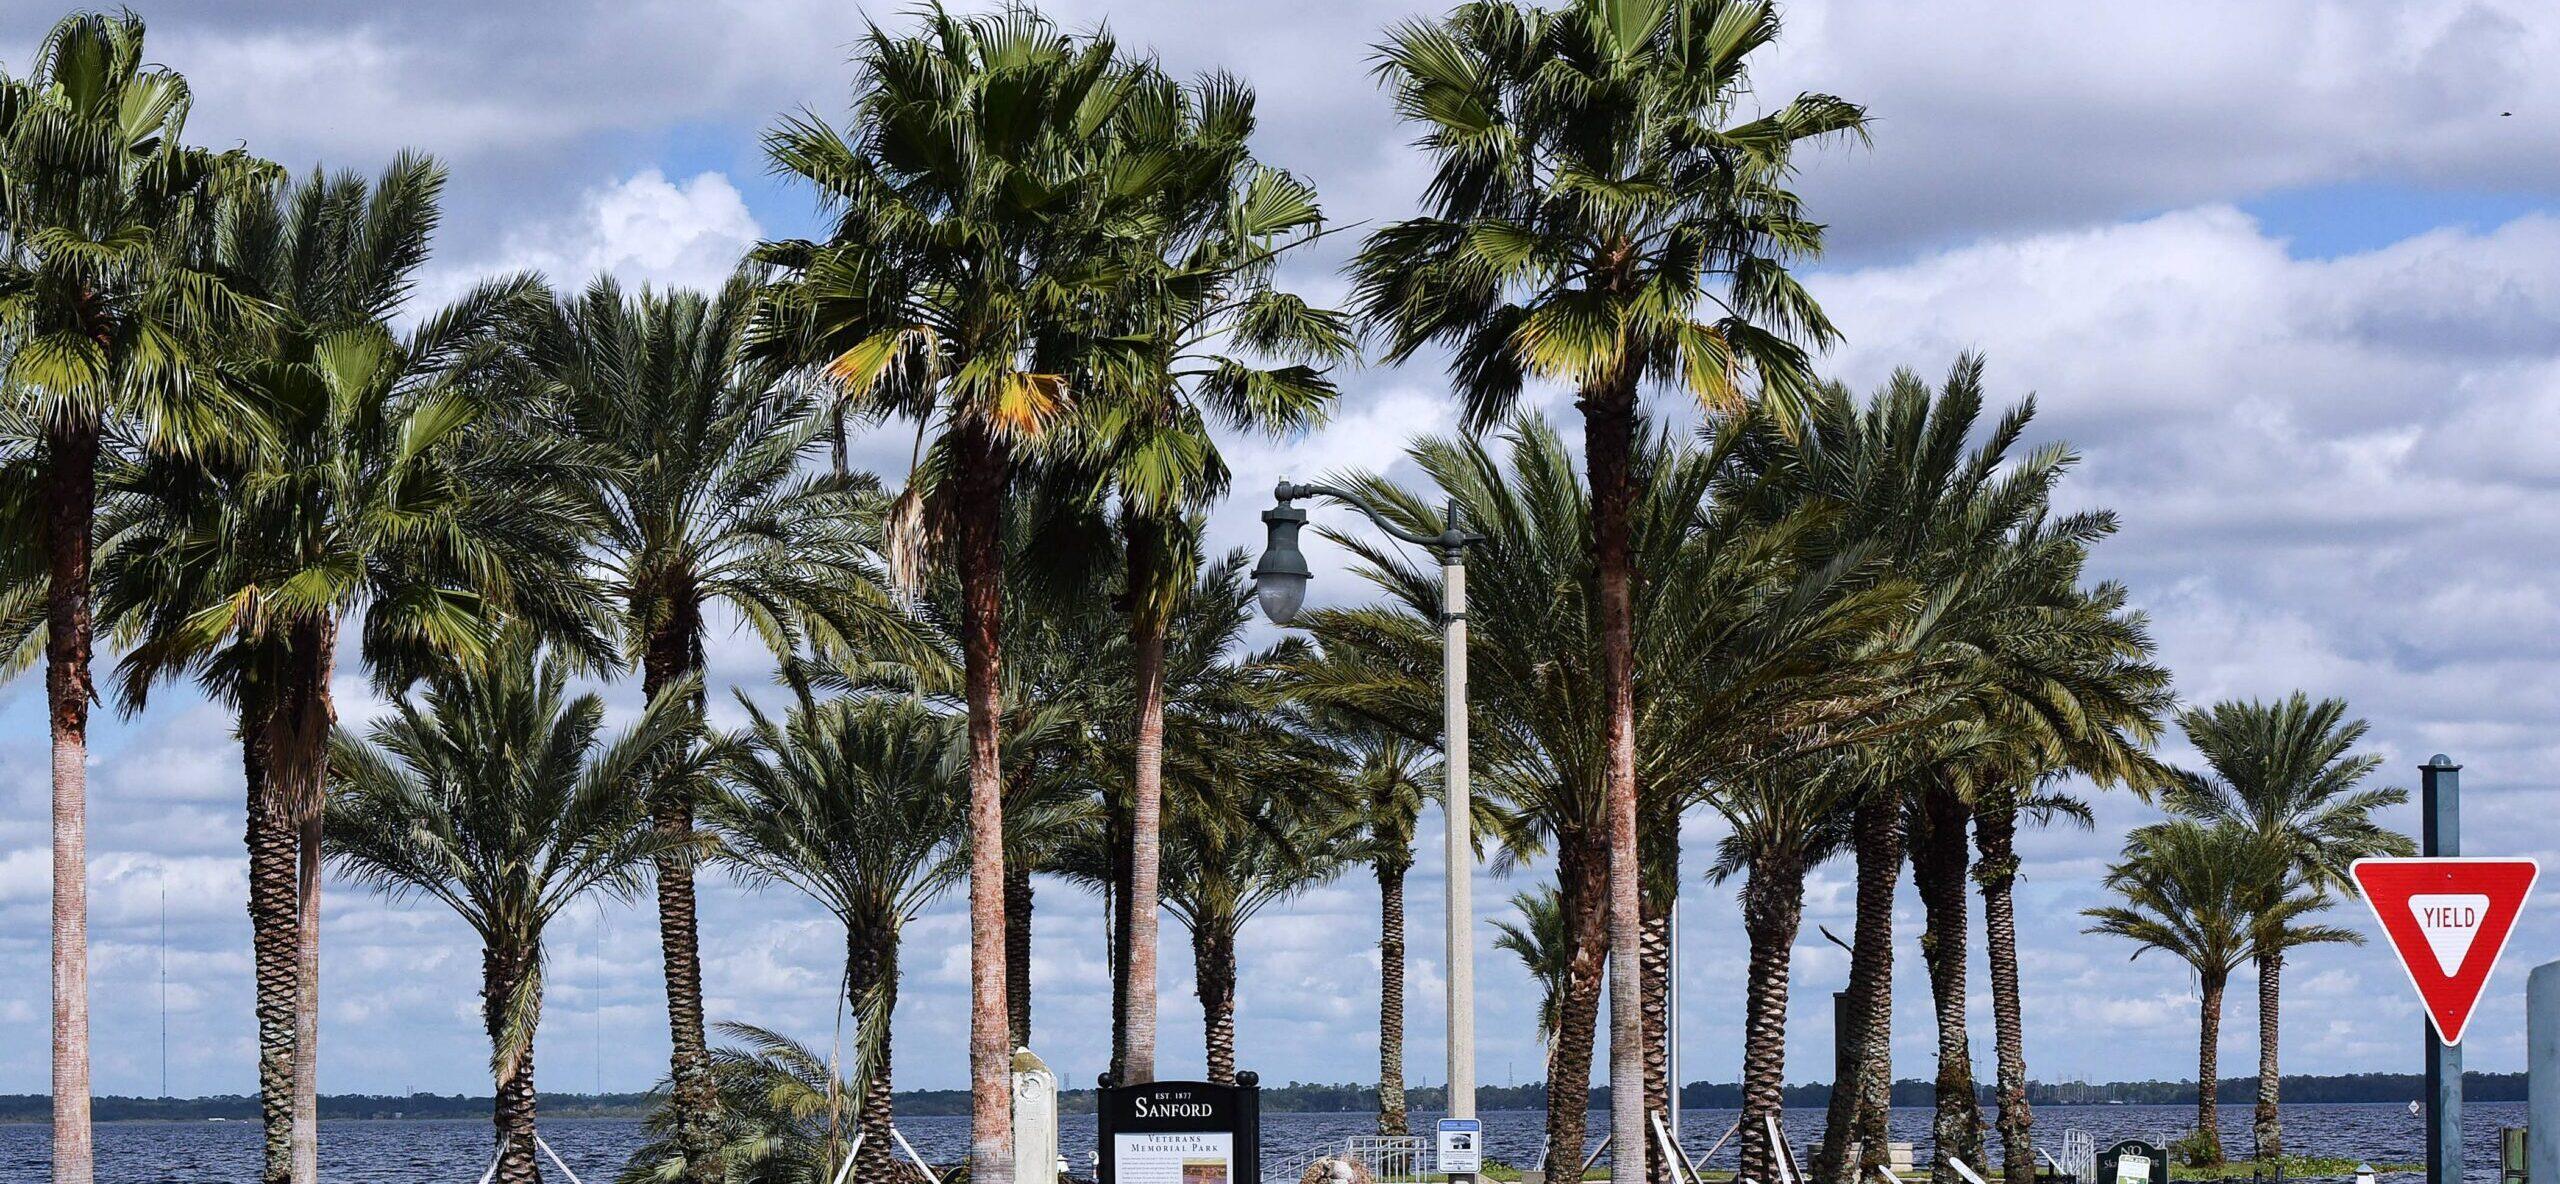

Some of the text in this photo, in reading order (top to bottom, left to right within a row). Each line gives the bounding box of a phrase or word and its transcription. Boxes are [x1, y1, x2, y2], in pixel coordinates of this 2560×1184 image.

[2424, 907, 2475, 928] YIELD
[1155, 1092, 1192, 1100] EST. 1877
[1135, 1096, 1213, 1118] SANFORD
[1148, 1134, 1202, 1143] VETERANS
[1131, 1143, 1219, 1152] MEMORIAL PARK
[2121, 1145, 2142, 1156] NO
